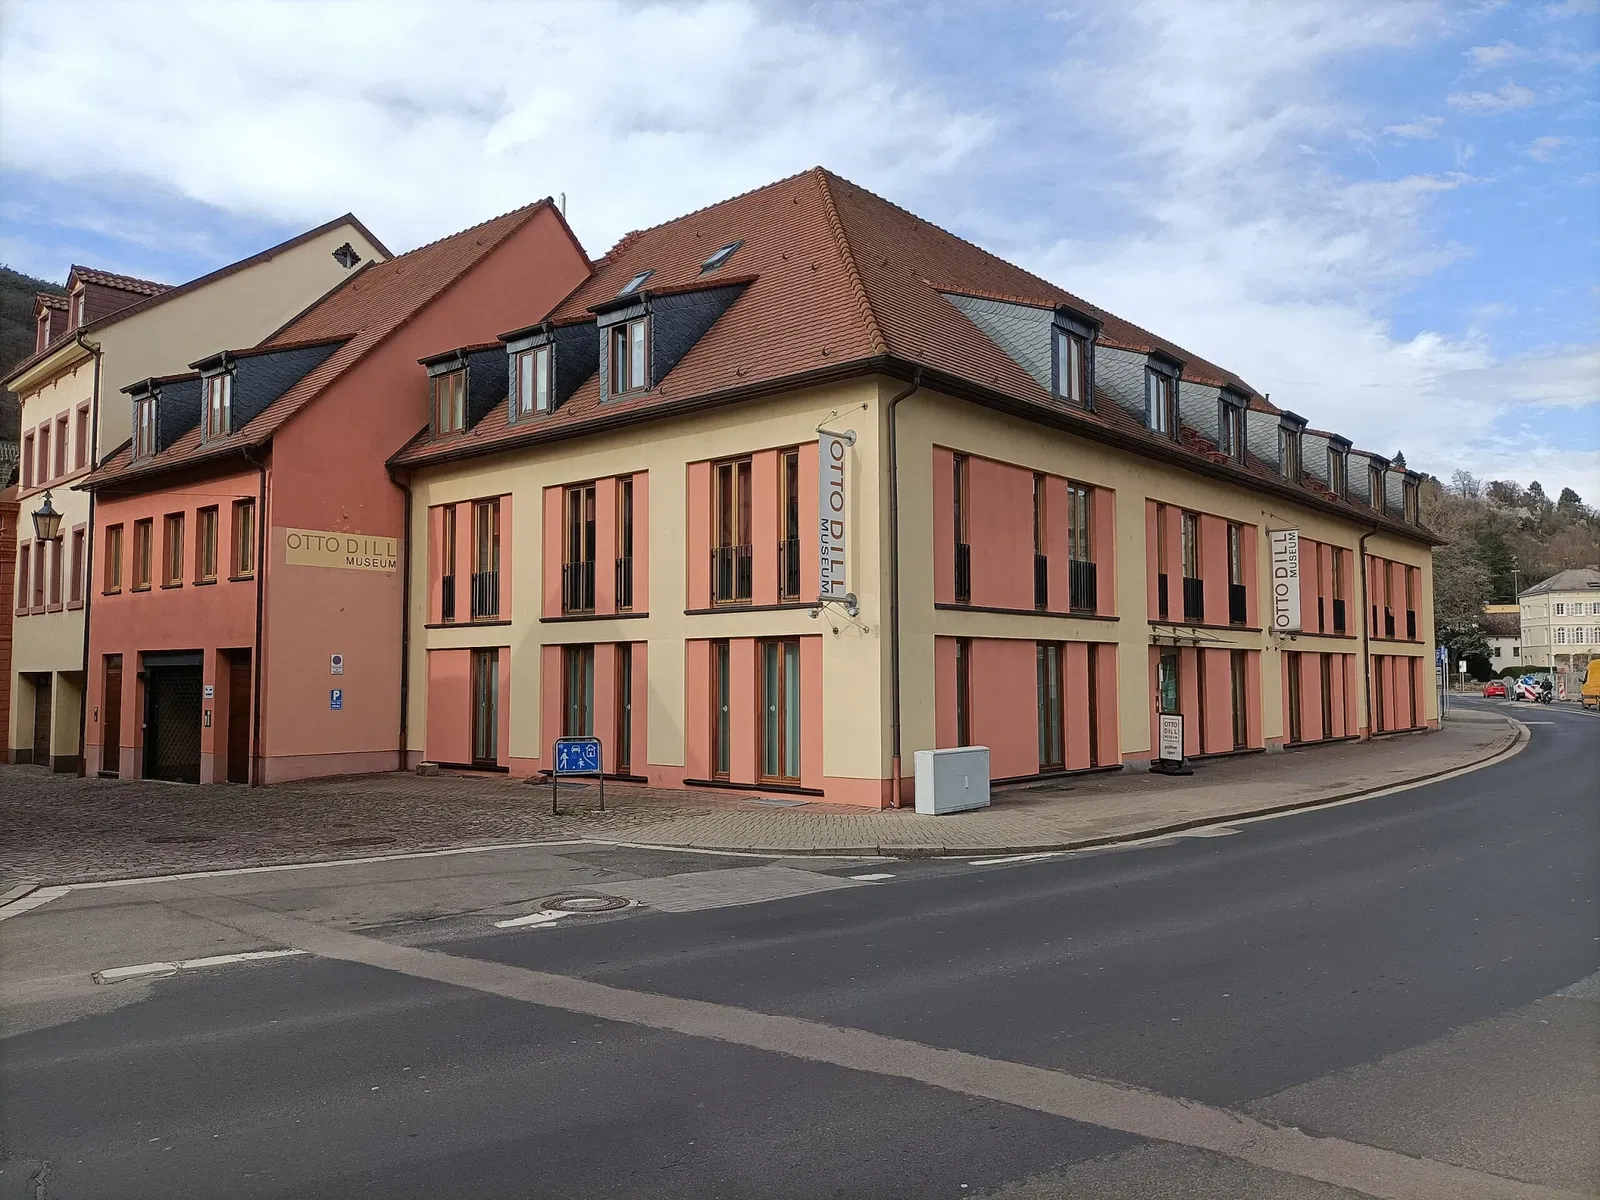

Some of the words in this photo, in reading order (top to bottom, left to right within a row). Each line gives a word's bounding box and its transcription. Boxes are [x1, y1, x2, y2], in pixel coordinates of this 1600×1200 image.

[829, 439, 844, 511] OTTO
[287, 533, 340, 553] OTTO
[346, 538, 396, 557] DILL
[345, 556, 397, 568] MUSEUM
[820, 518, 829, 593] MUSEUM
[829, 521, 844, 594] DILL
[1273, 533, 1288, 578] DILL
[1288, 532, 1297, 578] MUSEUM
[1275, 583, 1290, 627] OTTO
[333, 690, 340, 700] P
